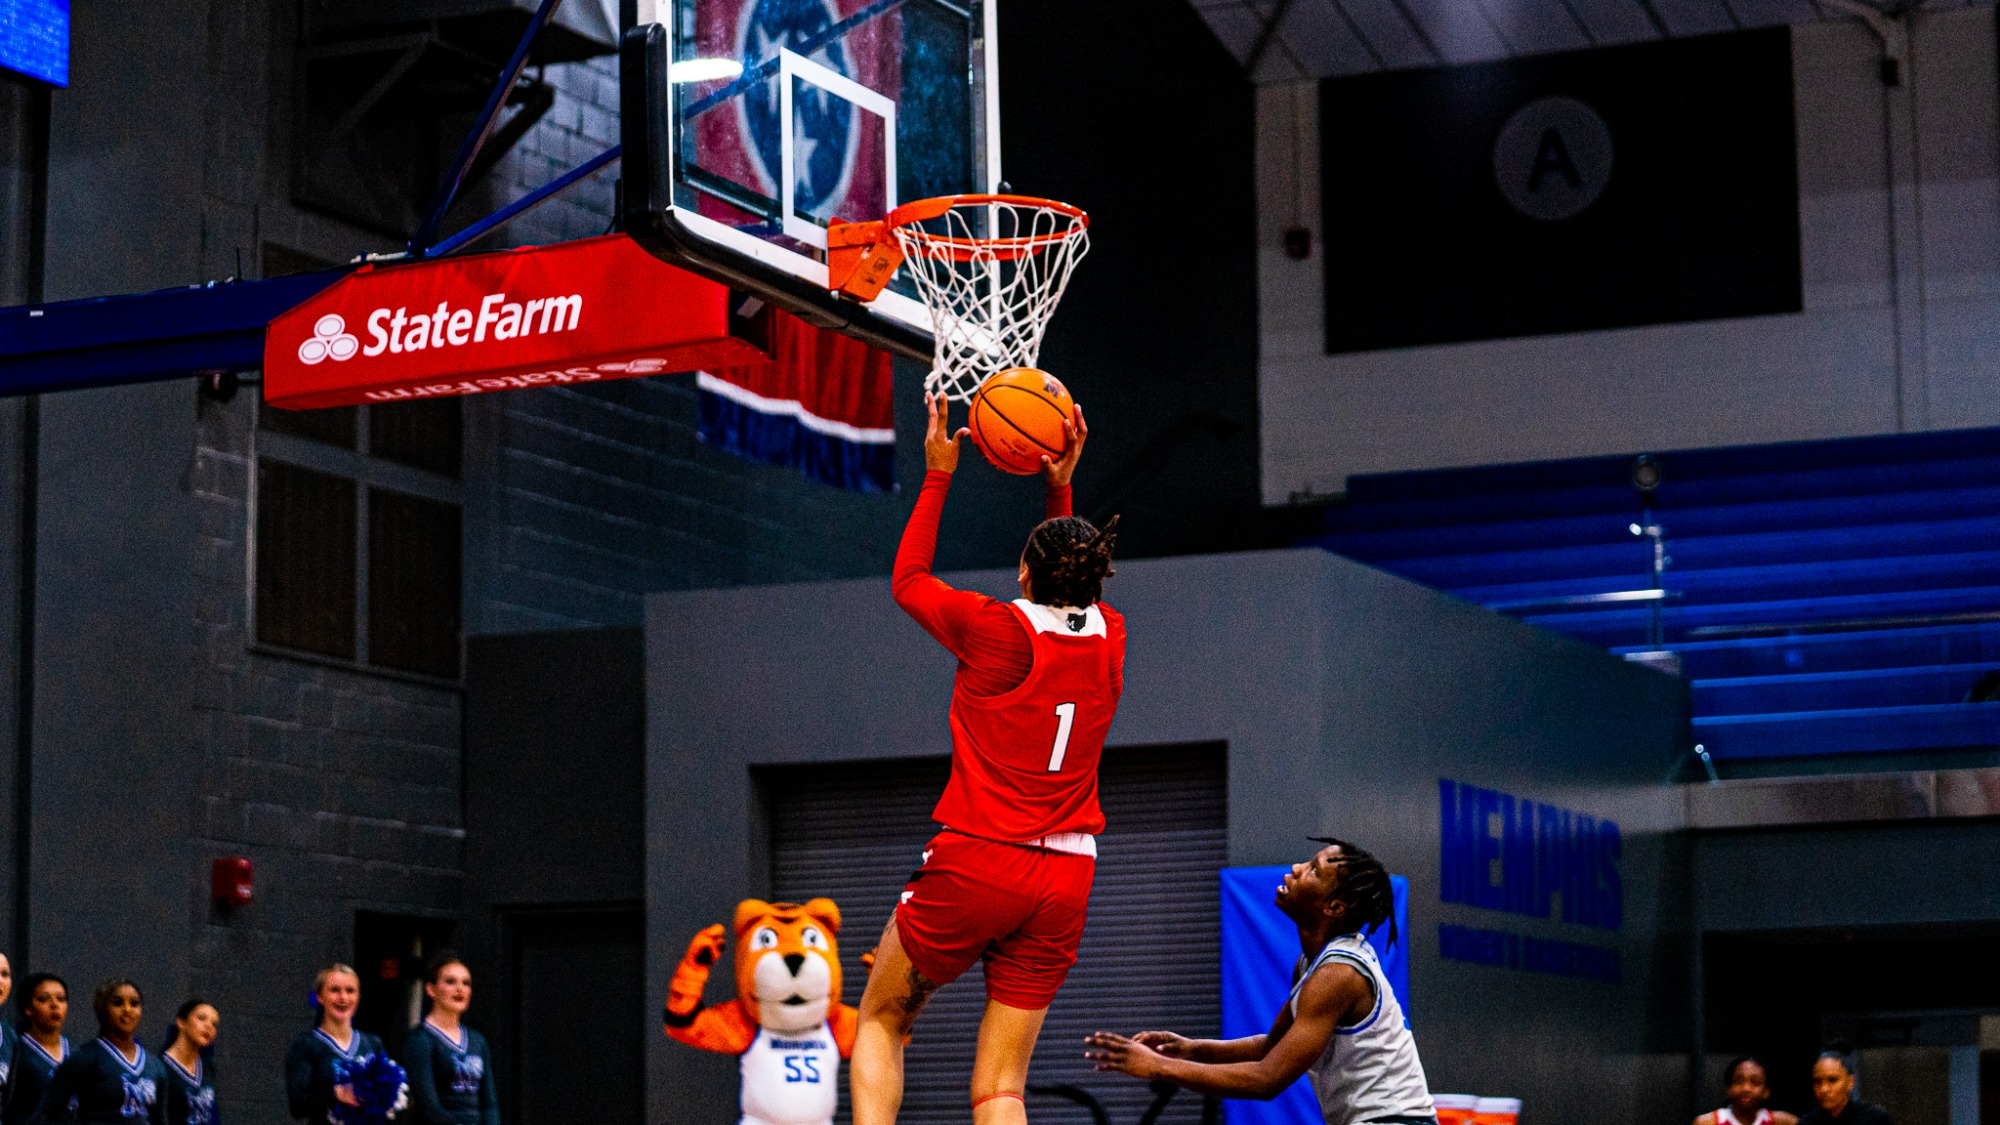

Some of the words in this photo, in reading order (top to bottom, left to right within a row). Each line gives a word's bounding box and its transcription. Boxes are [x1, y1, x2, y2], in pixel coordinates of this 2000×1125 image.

[1528, 127, 1581, 191] A
[1047, 702, 1076, 773] 1
[1439, 777, 1623, 931] MEMPHIS
[784, 1055, 820, 1083] 55
